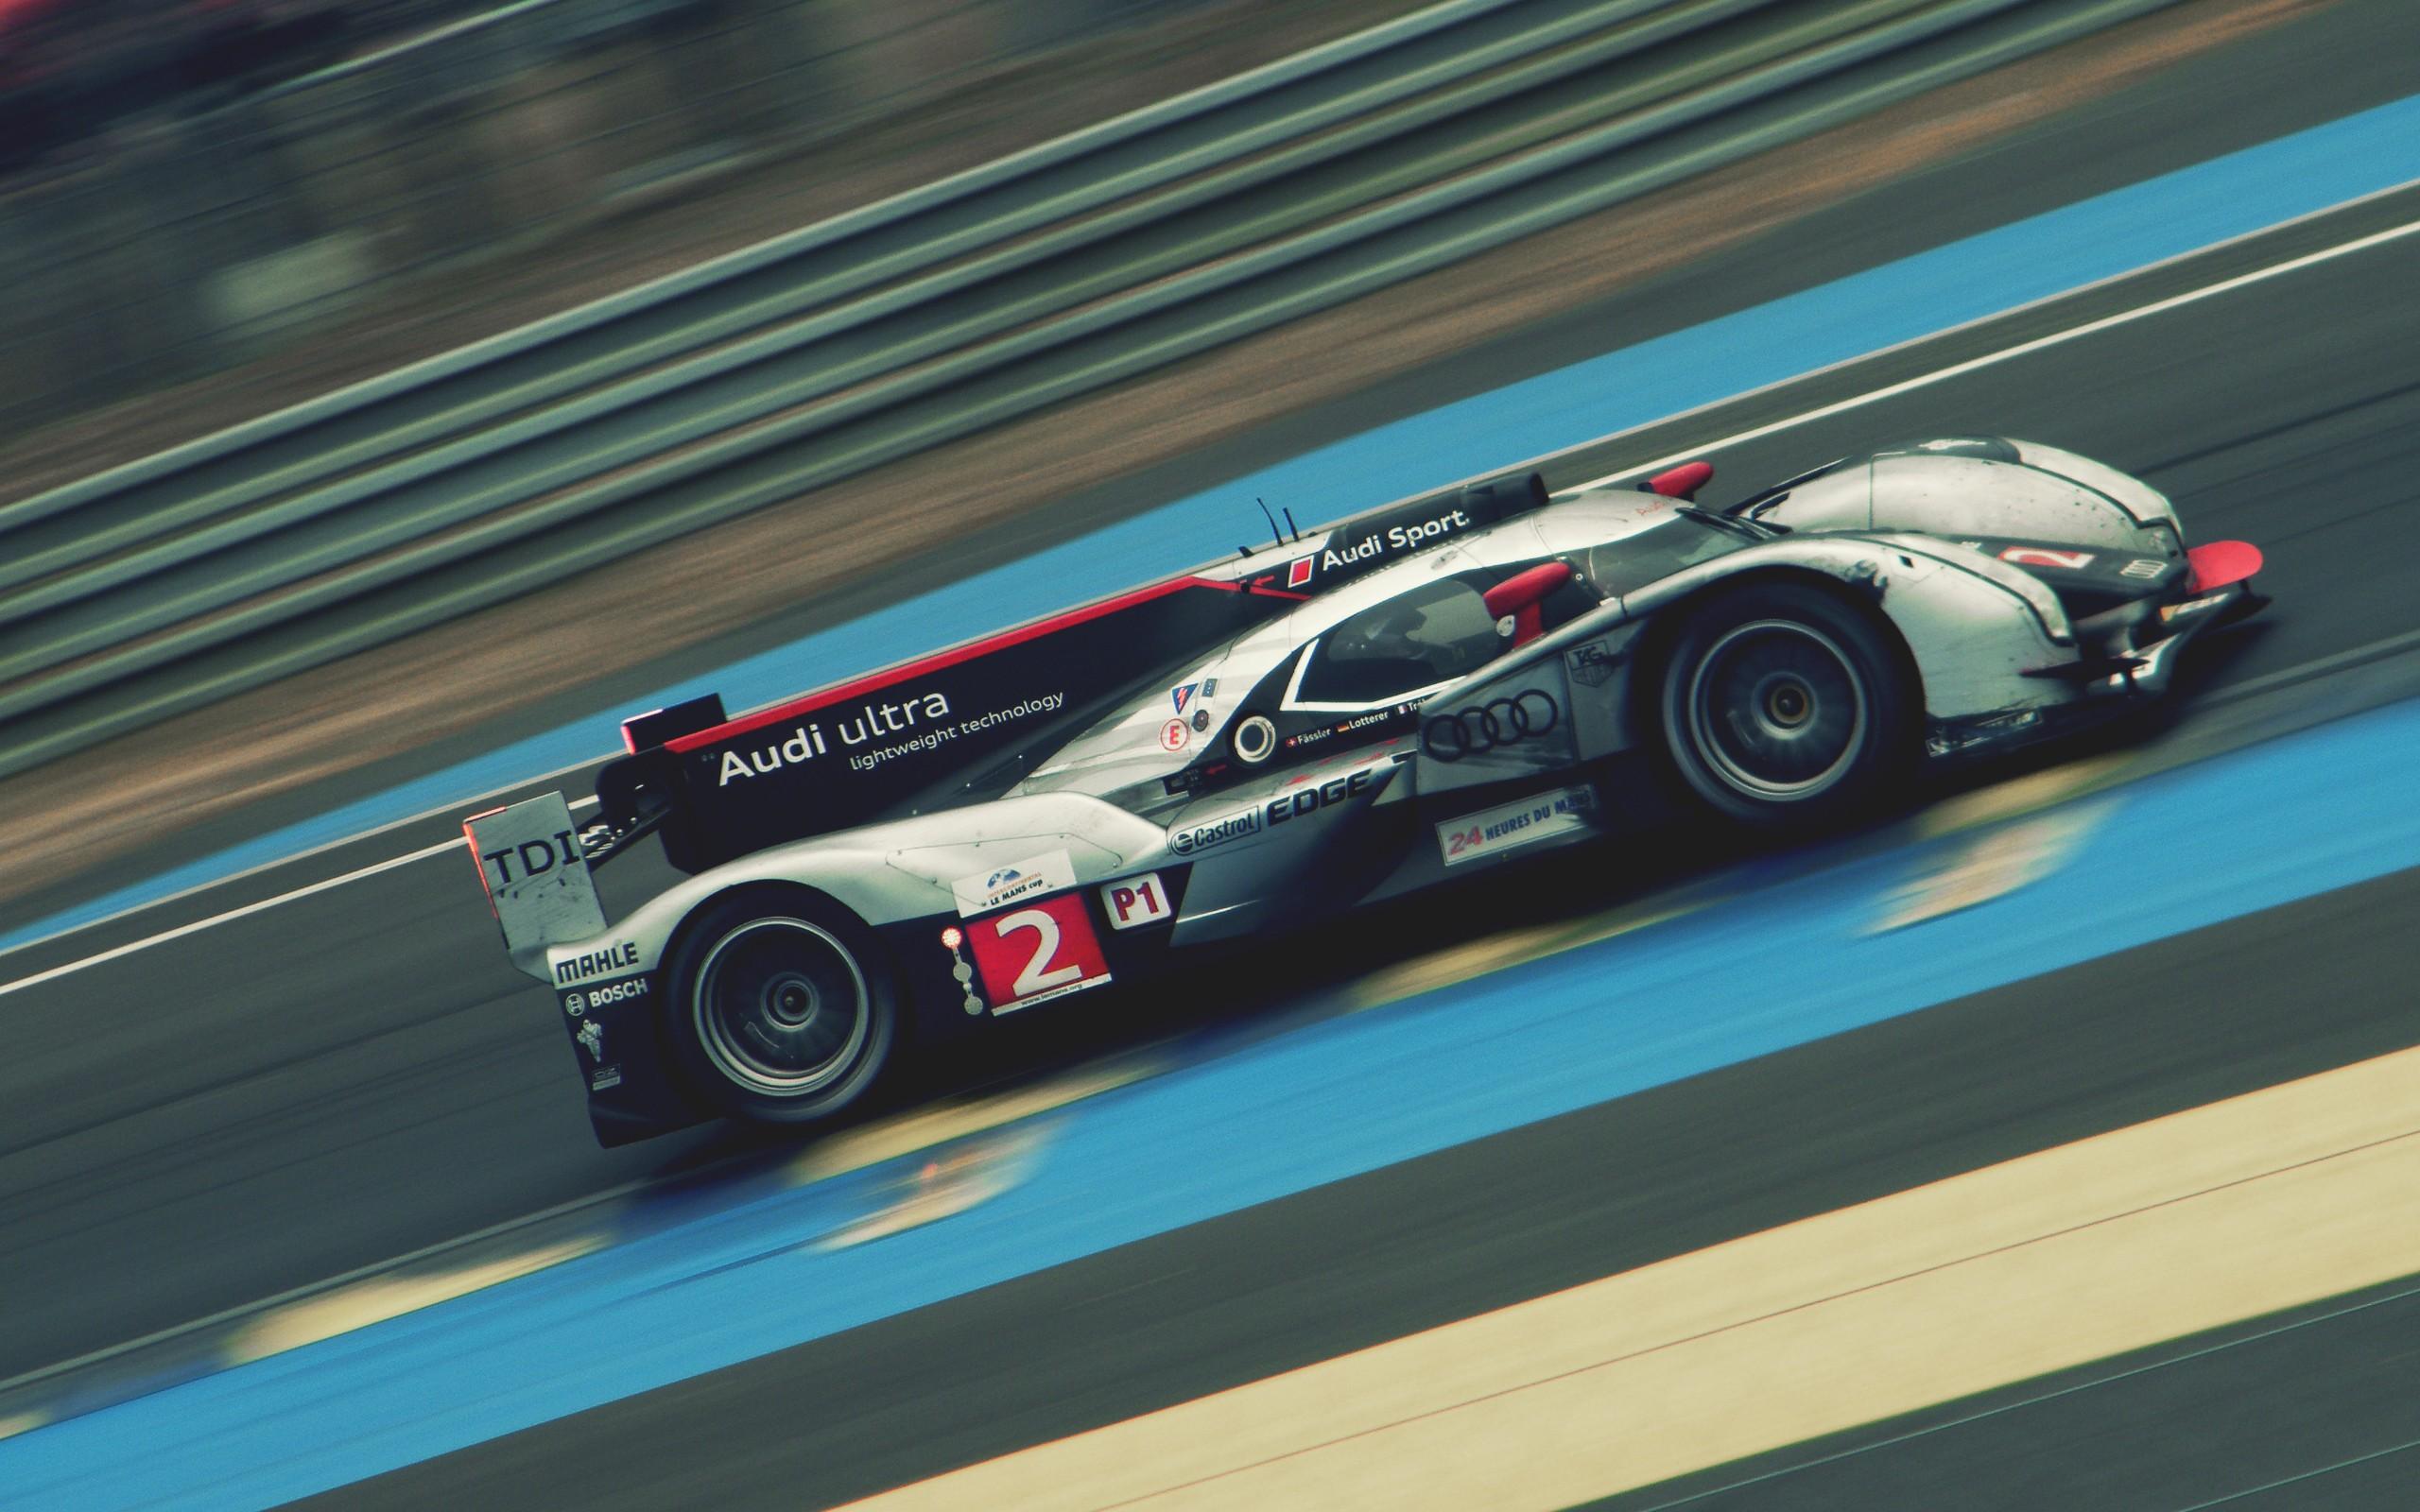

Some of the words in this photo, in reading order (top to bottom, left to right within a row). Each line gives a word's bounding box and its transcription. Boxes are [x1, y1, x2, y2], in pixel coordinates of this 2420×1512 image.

[1323, 535, 1382, 571] Audi
[1388, 510, 1466, 547] Sport
[718, 724, 828, 786] Audi
[838, 692, 950, 746] ultra
[850, 725, 958, 771] lightweight
[959, 691, 1063, 734] technology
[1169, 725, 1180, 745] E
[1297, 728, 1332, 745] Fässler
[1348, 711, 1390, 730] Lotterer
[1194, 814, 1254, 847] Castrol
[1267, 768, 1372, 827] EDGE
[1447, 825, 1484, 856] 24
[1485, 813, 1530, 841] HEURES
[1532, 803, 1551, 823] DU
[483, 830, 581, 885] TDI
[990, 897, 1000, 906] LE
[1002, 885, 1027, 901] MANS
[1028, 879, 1043, 888] cup
[1111, 881, 1159, 922] P1
[556, 942, 639, 985] MAHLE
[994, 909, 1082, 997] 2
[588, 978, 648, 1007] BOSCH
